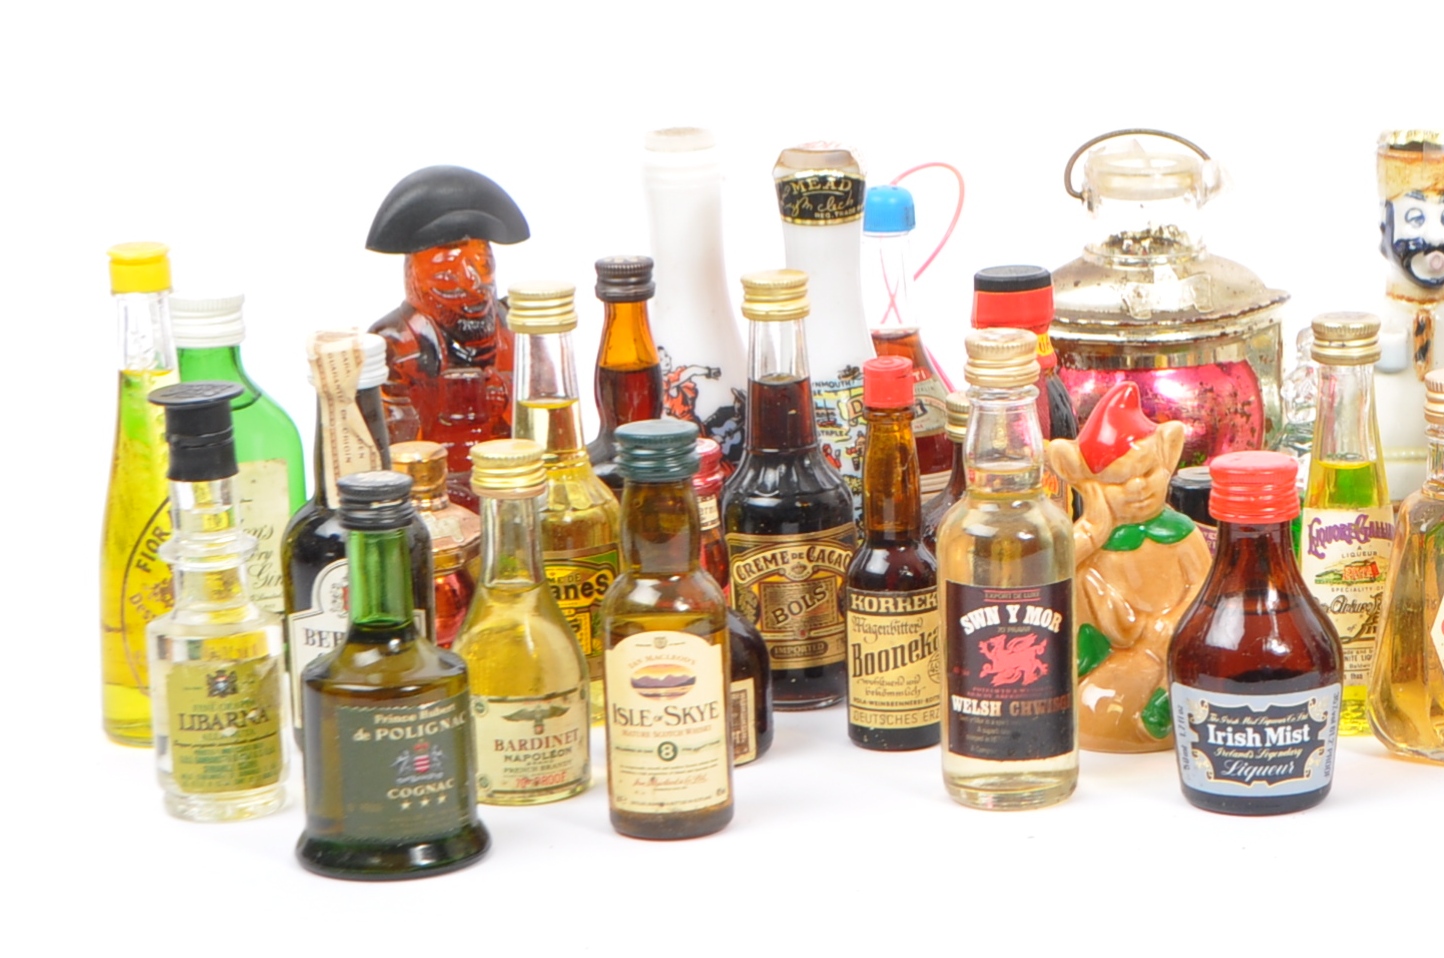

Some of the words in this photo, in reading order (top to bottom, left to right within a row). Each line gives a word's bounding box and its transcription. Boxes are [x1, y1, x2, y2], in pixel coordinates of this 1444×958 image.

[789, 177, 852, 195] MEAD
[912, 369, 927, 382] TI
[135, 526, 171, 574] FIOR
[1341, 551, 1378, 559] LIQUEUR
[734, 551, 789, 582] CREME
[791, 552, 805, 560] DE
[806, 546, 852, 571] CACAO
[771, 583, 828, 625] BOLS
[850, 593, 939, 613] KORREK
[959, 605, 1001, 635] SWN
[1005, 604, 1020, 624] Y
[1022, 605, 1063, 634] MOR
[851, 626, 939, 679] Boonek
[612, 702, 654, 728] ISLE
[663, 699, 721, 727] SKYE
[852, 710, 919, 726] DEUTSCHES
[922, 709, 940, 720] ERZ
[951, 694, 1002, 717] WELSH
[352, 727, 372, 742] de
[374, 710, 468, 742] POLIGNAC
[373, 712, 417, 725] Prince
[494, 727, 580, 752] BARDINET
[1207, 723, 1263, 748] Irish
[1263, 723, 1311, 748] Mist
[659, 742, 676, 761] 8
[1220, 759, 1295, 783] Liqueur
[386, 777, 456, 800] COGNAC
